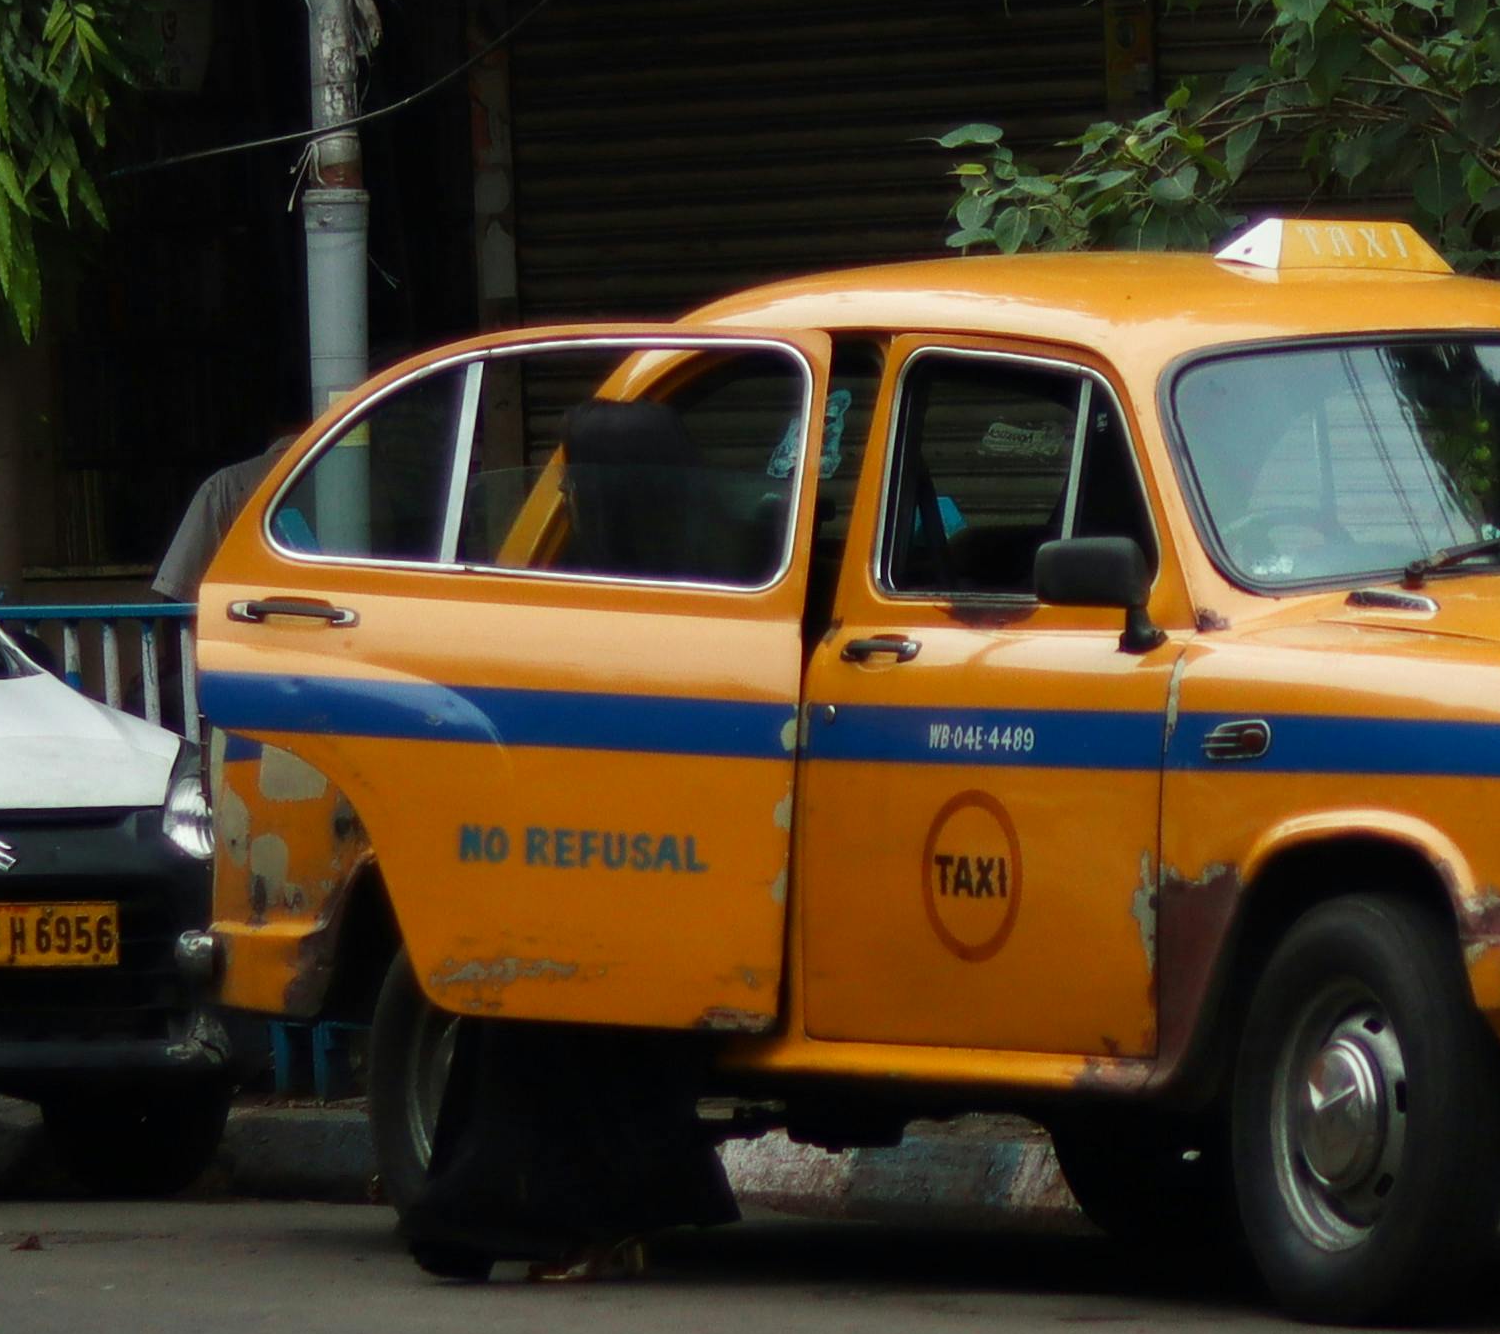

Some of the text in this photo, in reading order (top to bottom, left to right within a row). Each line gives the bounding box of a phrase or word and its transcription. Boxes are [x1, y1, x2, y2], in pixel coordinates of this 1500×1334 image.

[1298, 224, 1411, 260] TAXI
[457, 824, 708, 873] NO REFUSAL
[934, 853, 1008, 900] TAXI
[10, 917, 26, 955] H
[35, 915, 114, 955] 6956
